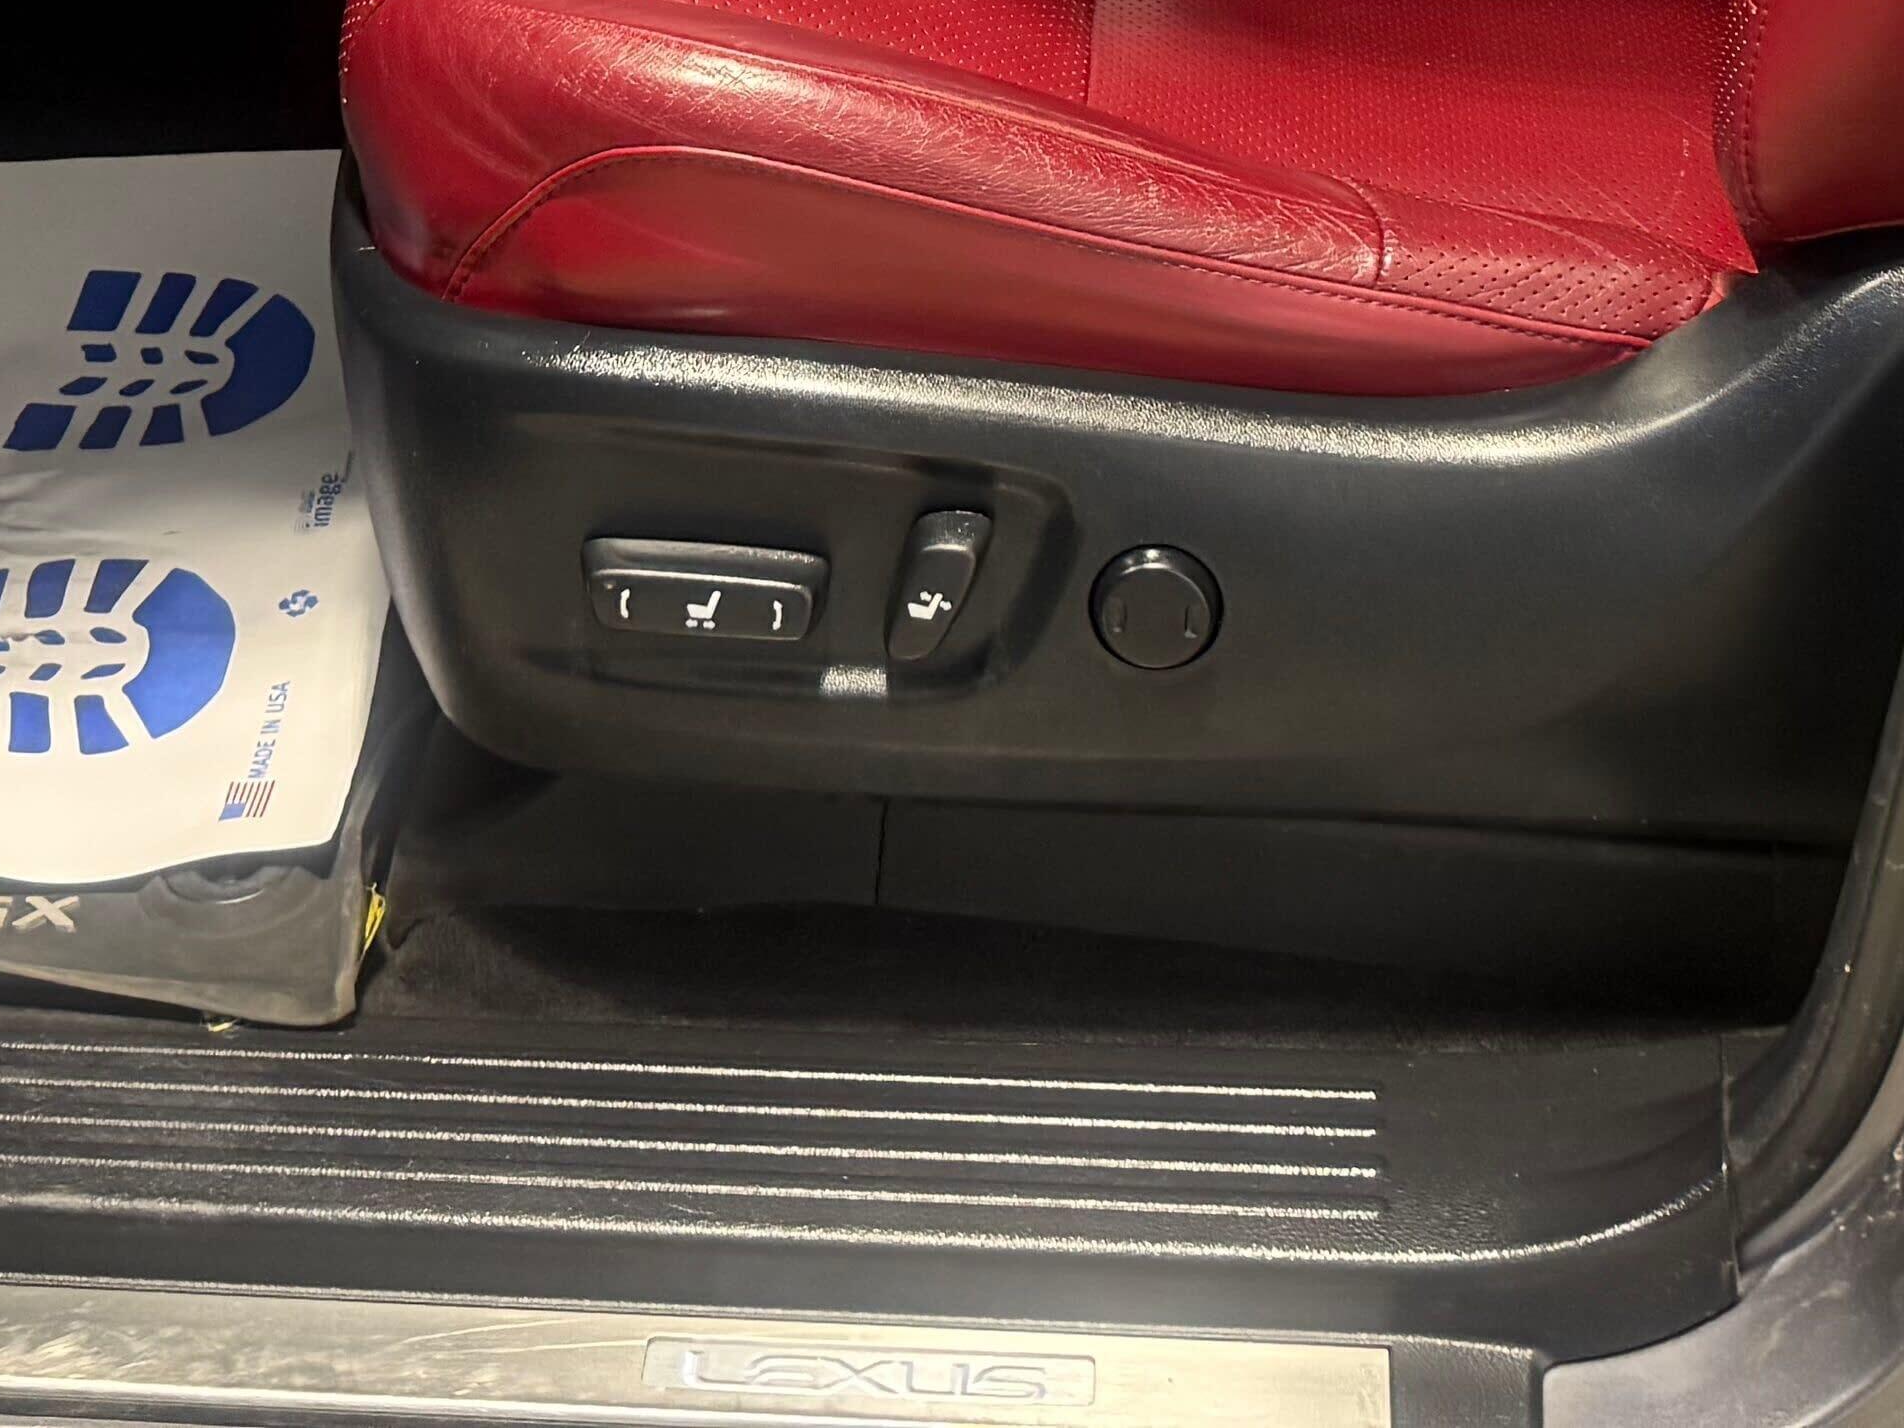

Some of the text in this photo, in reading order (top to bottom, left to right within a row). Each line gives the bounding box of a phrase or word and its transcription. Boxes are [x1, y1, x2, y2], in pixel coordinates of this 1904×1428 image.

[313, 471, 342, 527] image
[248, 681, 290, 778] MADE IN USA
[682, 1348, 1048, 1401] LEXUS
